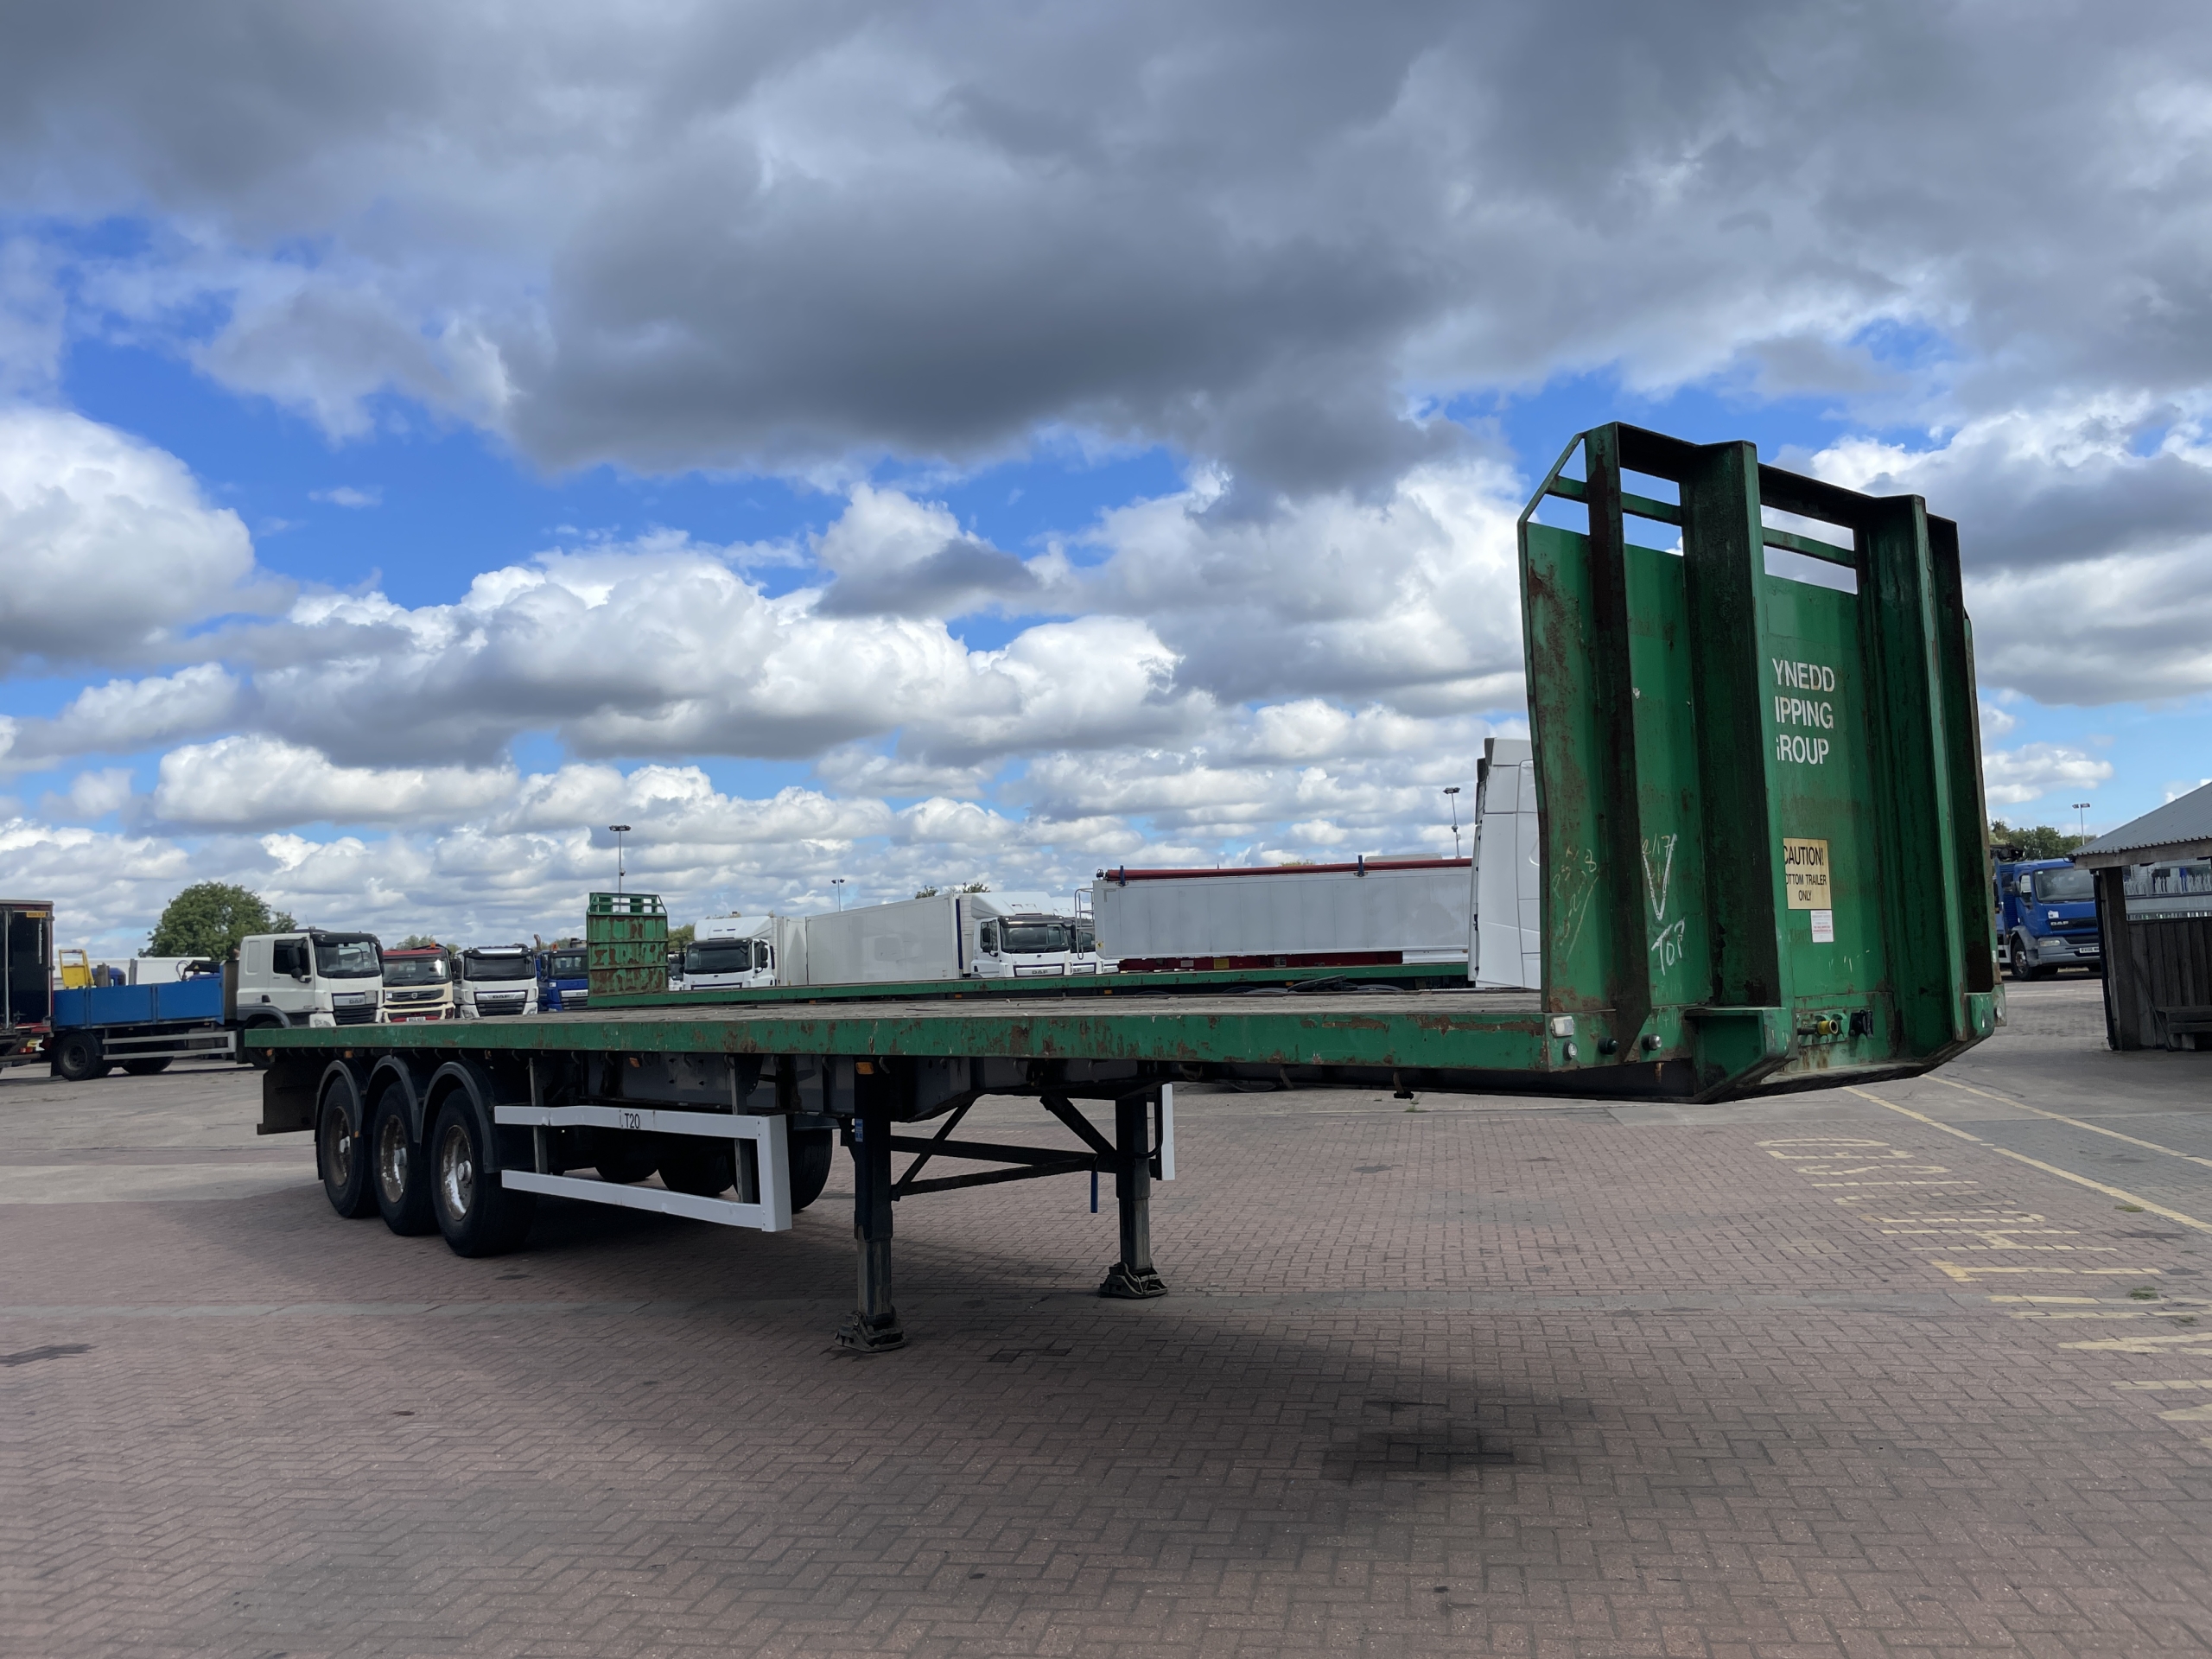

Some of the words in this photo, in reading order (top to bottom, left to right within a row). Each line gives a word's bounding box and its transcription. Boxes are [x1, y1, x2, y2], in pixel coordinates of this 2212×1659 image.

[1771, 658, 1835, 692] YNEDD
[1774, 696, 1834, 728] IPPING
[1805, 874, 1827, 886] TRAILER
[1798, 889, 1812, 901] ONLY
[624, 1113, 640, 1129] T20
